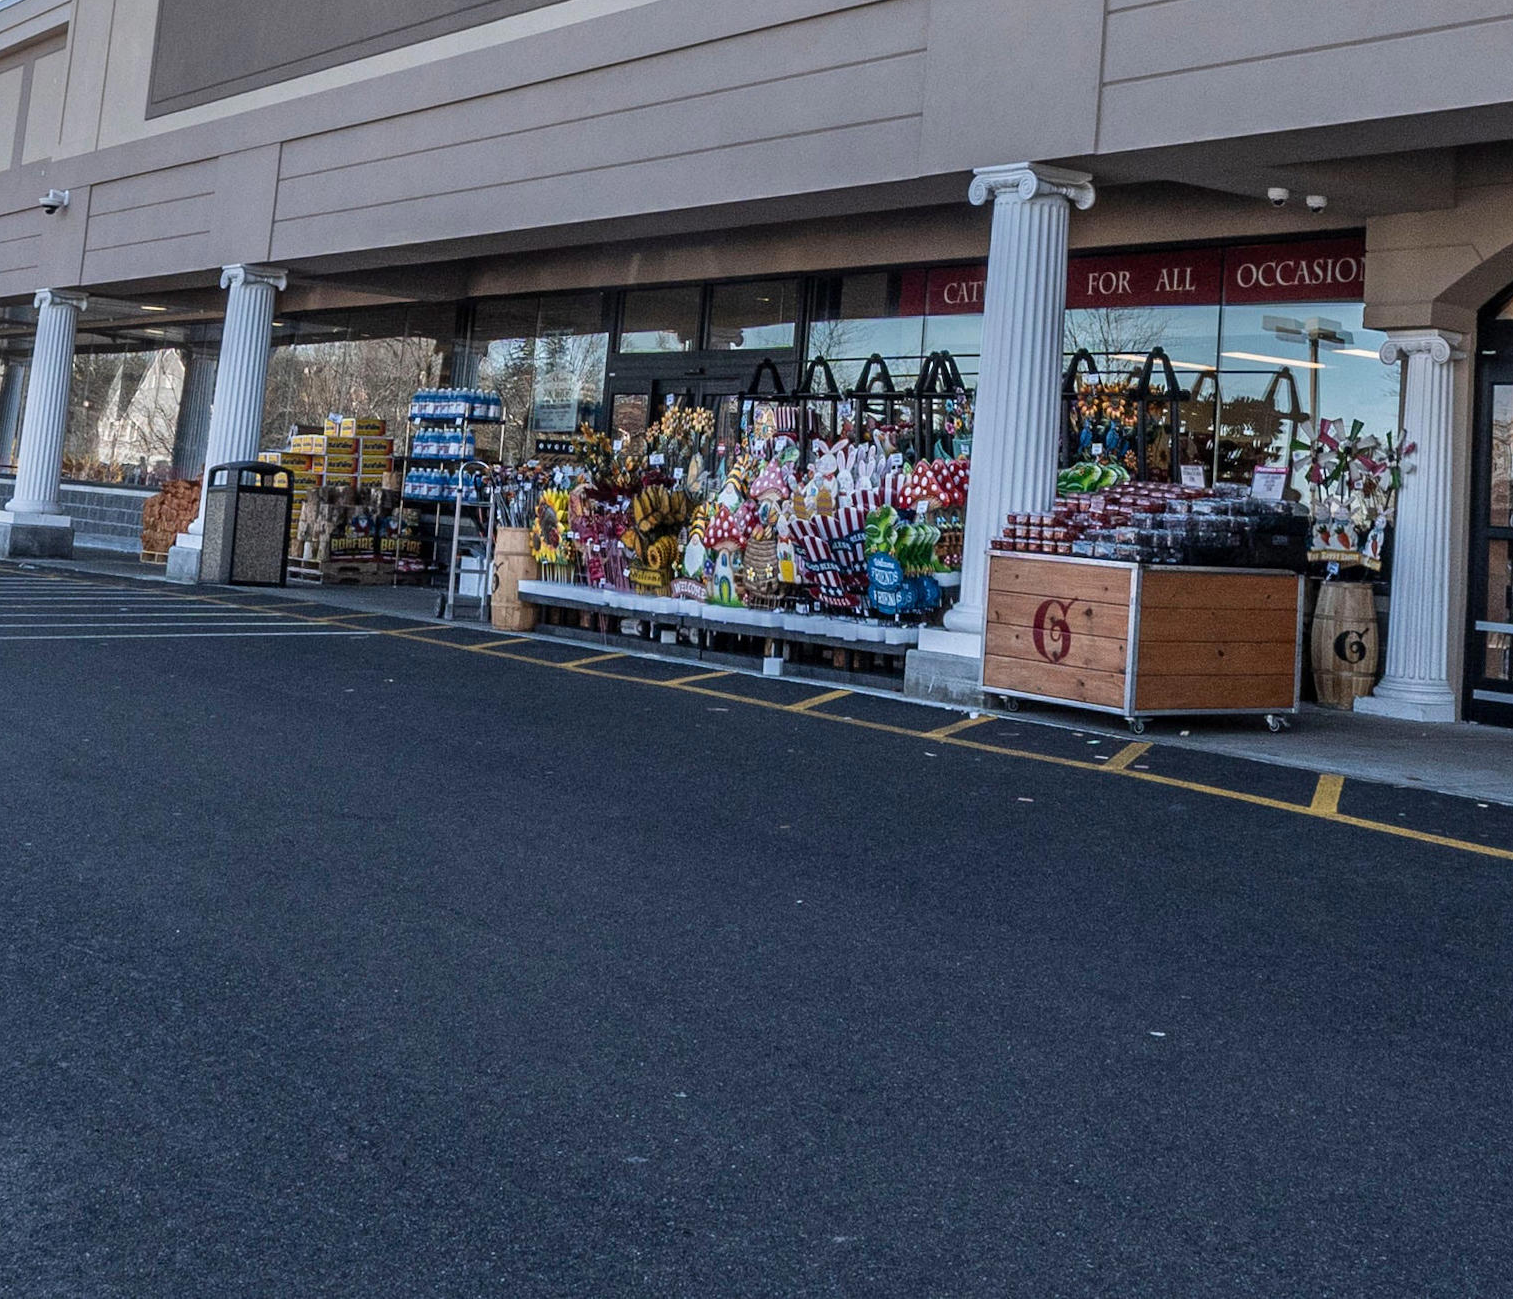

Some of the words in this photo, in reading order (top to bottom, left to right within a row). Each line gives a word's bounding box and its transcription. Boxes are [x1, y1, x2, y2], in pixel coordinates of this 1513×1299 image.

[943, 280, 987, 305] CAT
[1087, 270, 1132, 296] FOR
[1155, 267, 1196, 292] ALL
